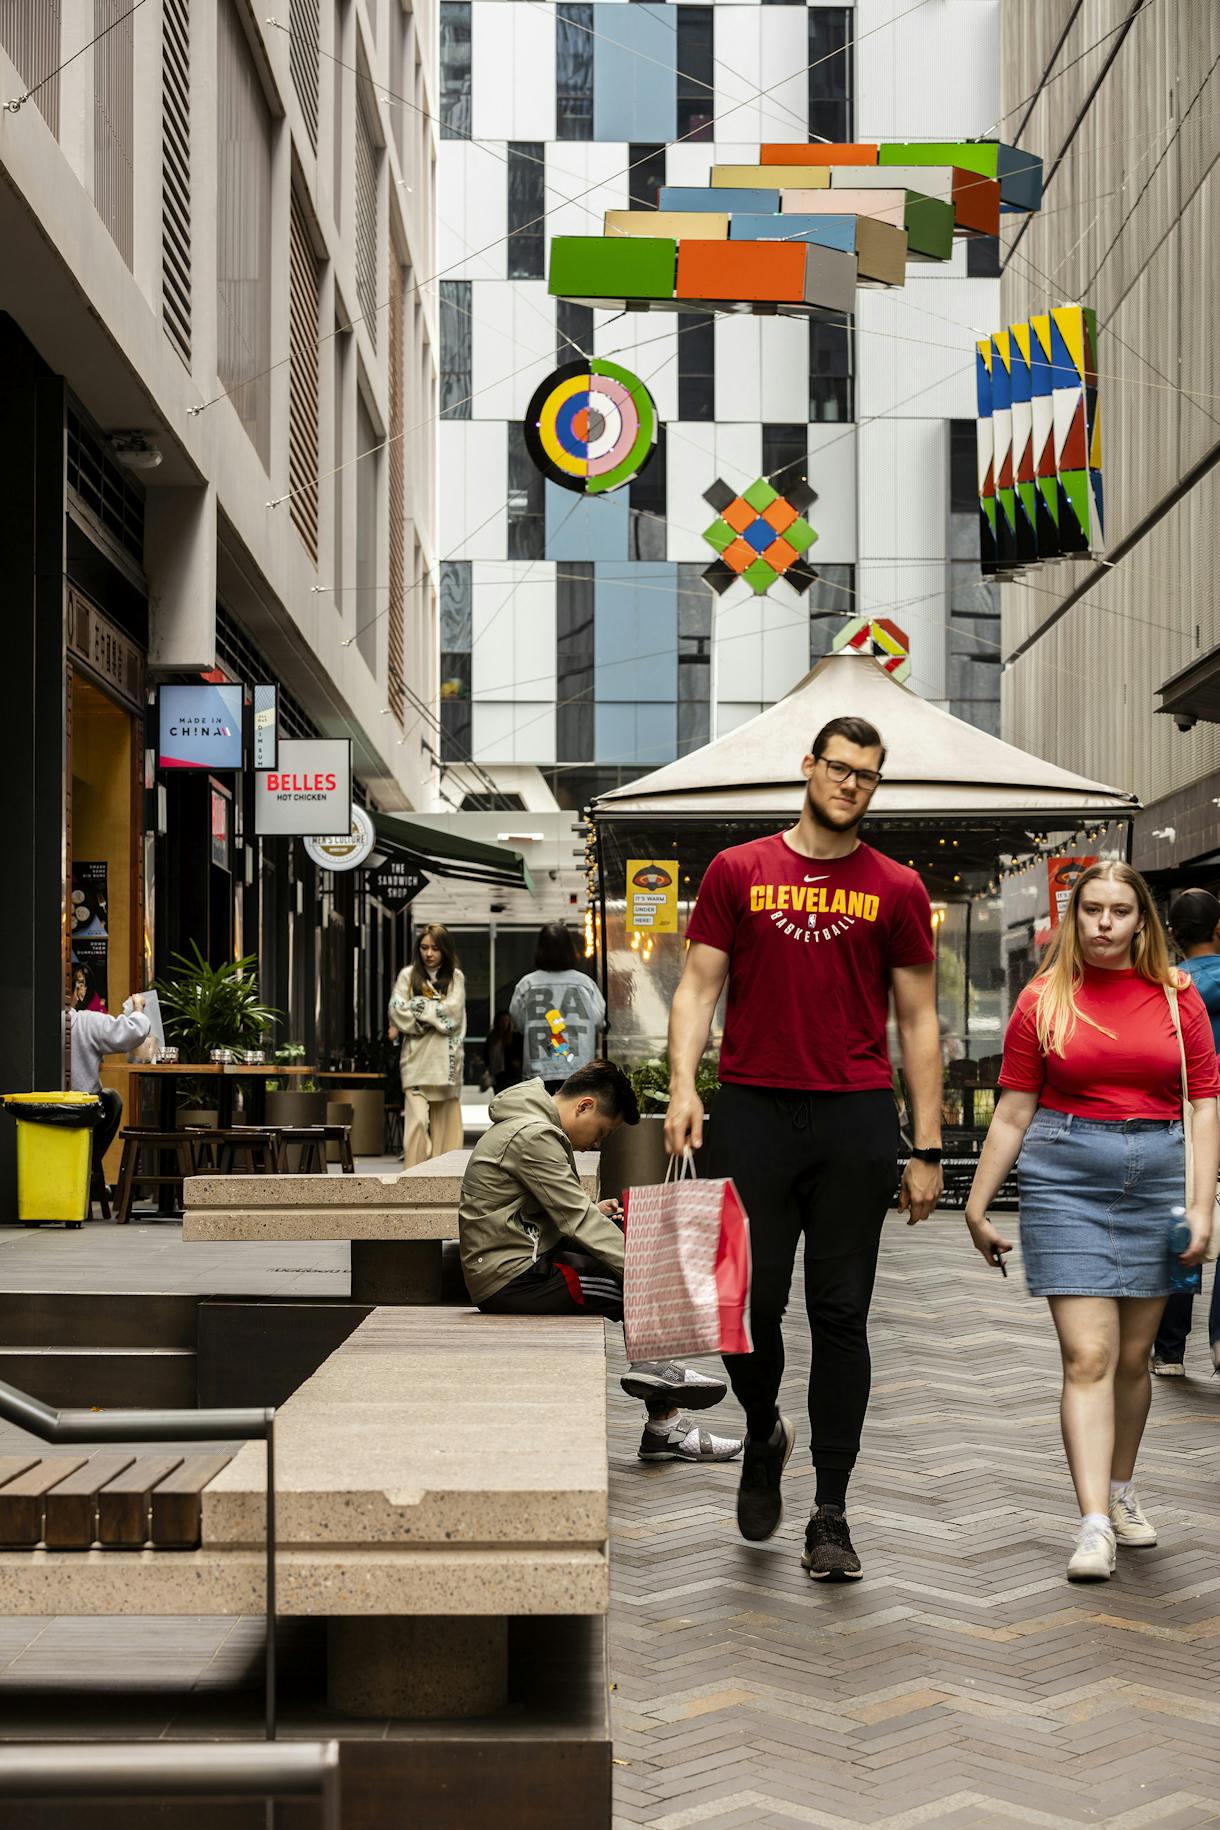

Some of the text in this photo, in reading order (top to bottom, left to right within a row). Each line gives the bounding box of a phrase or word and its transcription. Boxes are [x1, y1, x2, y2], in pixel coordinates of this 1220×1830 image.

[266, 774, 337, 791] BELLES
[391, 863, 405, 874] THE
[378, 875, 418, 886] SANDWICH
[387, 888, 408, 898] SHOP
[750, 884, 880, 922] CLEVELAND
[770, 911, 855, 942] BASKETBALL
